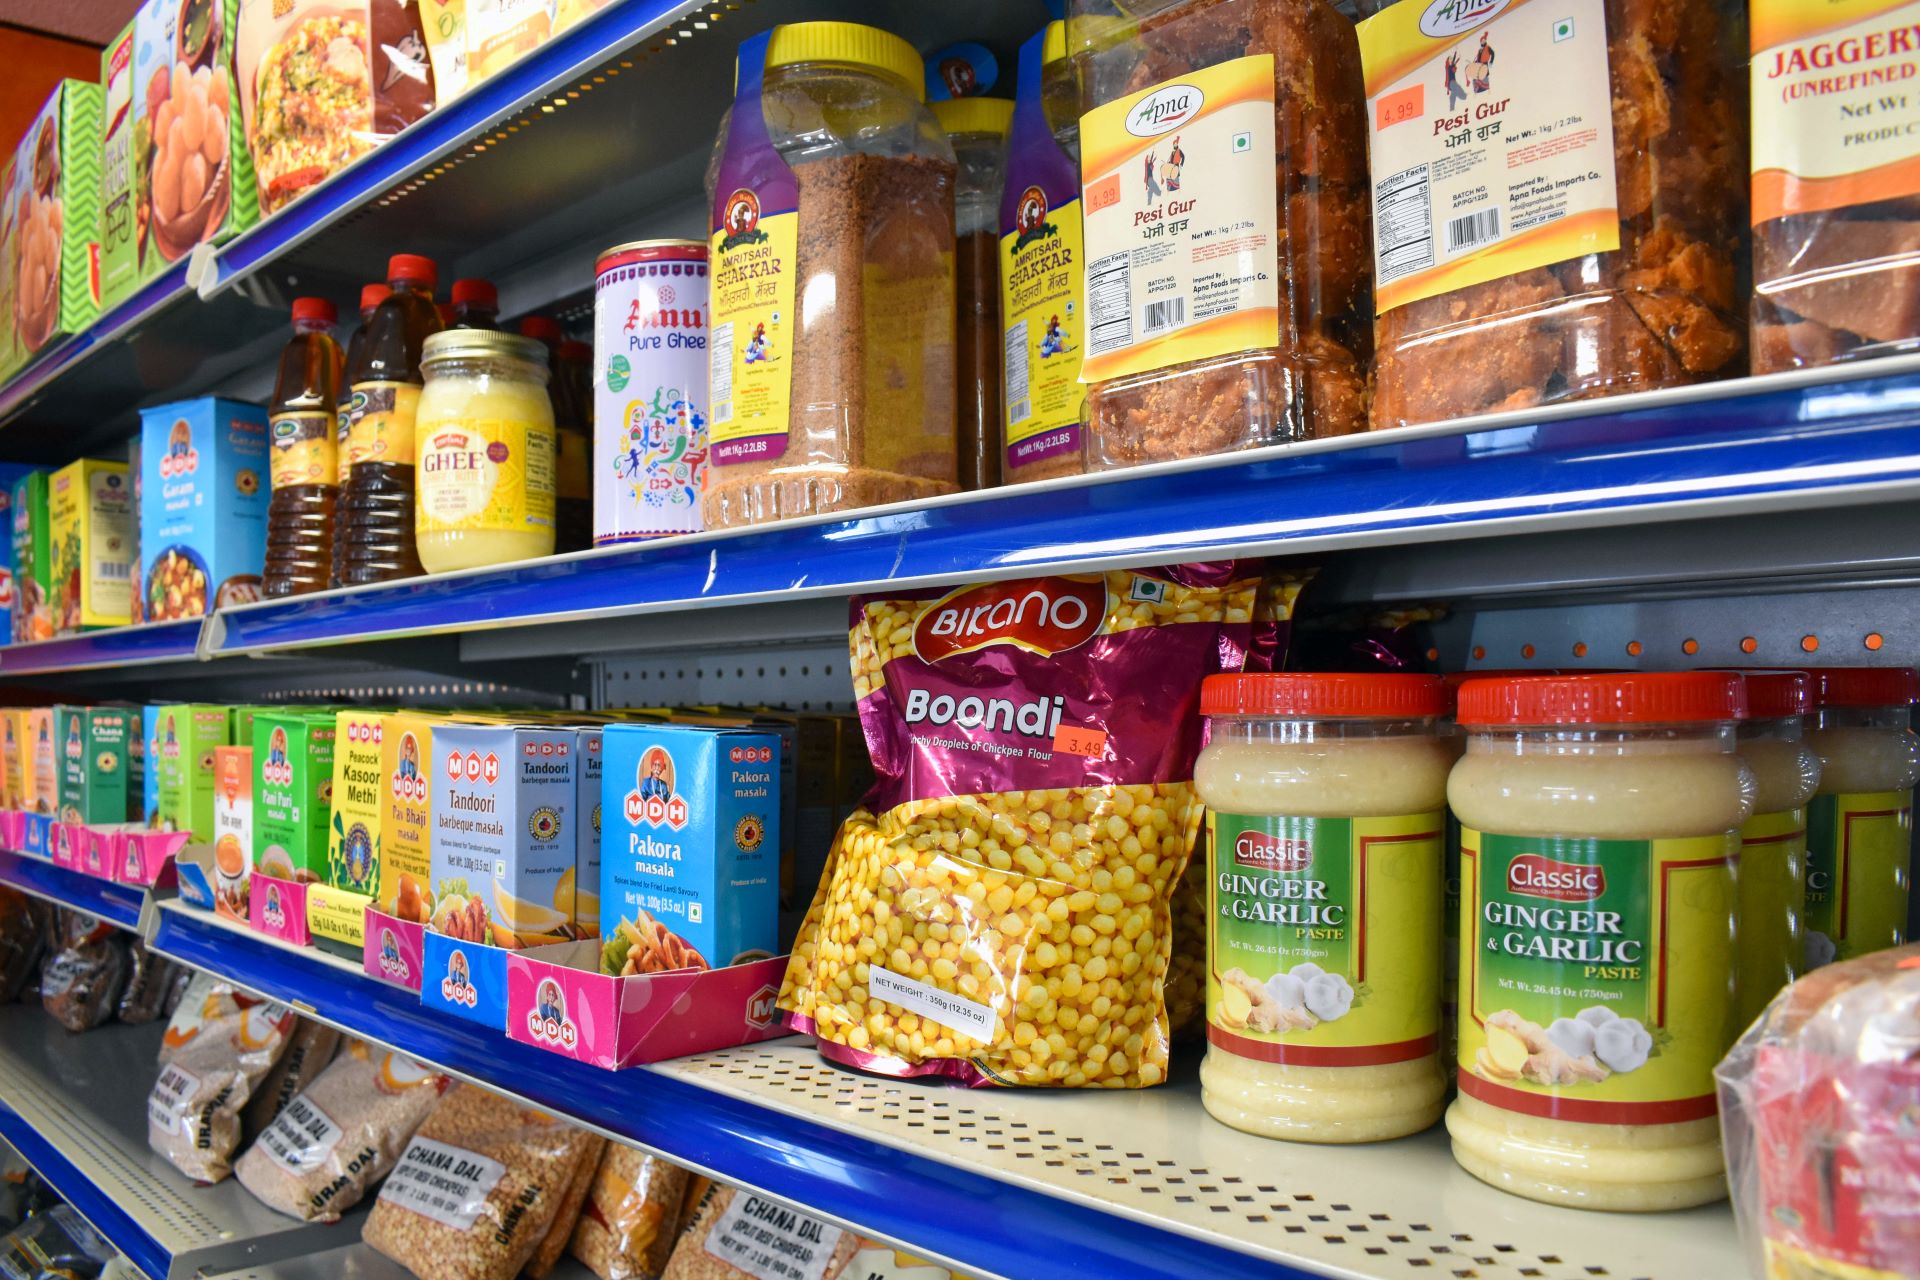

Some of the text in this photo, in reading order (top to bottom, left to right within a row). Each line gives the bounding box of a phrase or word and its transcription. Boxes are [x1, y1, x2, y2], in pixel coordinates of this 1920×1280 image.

[1782, 62, 1917, 104] (UNREFINED
[1135, 95, 1190, 127] Apna
[1384, 101, 1415, 124] 4.99
[1432, 97, 1511, 136] Pesi Gur
[1841, 95, 1908, 120] Net Wt
[1505, 135, 1519, 144] Net
[1539, 124, 1552, 133] 1kg
[1559, 115, 1583, 127] 2.2lbs
[1376, 174, 1404, 191] Nutrition
[1405, 165, 1427, 178] Facts
[1418, 184, 1428, 194] 55
[1509, 171, 1602, 203] Apna Foods Imports Co.
[1092, 188, 1116, 208] 4.99
[1452, 185, 1488, 201] BATCH NO.
[1133, 199, 1197, 227] Pesi Gur
[1191, 231, 1203, 241] Net
[1235, 221, 1255, 232] 2.2lbs
[722, 246, 772, 269] AMRITSARI
[1014, 237, 1062, 270] AMRITSARI
[1111, 252, 1129, 263] Facts
[716, 258, 782, 290] SHAKKAR
[1009, 248, 1073, 292] SHAKKAR
[1121, 269, 1129, 277] 55
[1147, 276, 1176, 288] BATCH NO.
[1192, 282, 1209, 294] Apna
[1210, 279, 1229, 290] Foods
[1257, 272, 1269, 281] Co.
[1194, 308, 1214, 319] PRODUCT
[1214, 306, 1222, 315] OF
[629, 332, 706, 351] Pure Ghee
[424, 452, 485, 473] GHEE
[163, 481, 195, 499] Garam
[905, 688, 1065, 740] Boondi
[348, 726, 382, 739] MDH
[349, 750, 379, 766] Peacock
[524, 743, 569, 754] MDH
[731, 750, 771, 761] MDH
[933, 736, 970, 752] Droplets
[982, 742, 1024, 758] Chickpea
[1027, 747, 1053, 761] Flour
[1069, 738, 1101, 756] 3.49
[449, 757, 499, 778] MDH
[523, 762, 569, 775] Tandoori
[731, 770, 771, 785] Pakora
[393, 780, 425, 797] MDH
[521, 776, 570, 785] barbeque masala
[347, 785, 377, 806] Methi
[449, 790, 495, 814] Tandoori
[735, 787, 767, 798] masala
[392, 804, 427, 830] Pav Bhaji
[628, 799, 684, 822] MDH
[439, 813, 504, 837] barbeque masala
[629, 833, 682, 862] Pakora
[1235, 838, 1306, 863] Classic
[525, 867, 546, 875] Produce
[552, 866, 565, 874] India
[635, 861, 675, 878] masala
[1509, 863, 1599, 890] Classic
[614, 875, 630, 887] Spices
[630, 878, 643, 889] blend
[642, 880, 650, 890] for
[650, 882, 663, 892] Fried
[677, 886, 700, 899] Savoury
[1219, 872, 1328, 901] GINGER
[1540, 888, 1565, 897] Quality
[625, 891, 685, 917] Net Wt. 100g (3.5 oz.)
[1221, 899, 1344, 926] & GARLIC
[1484, 901, 1623, 935] GINGER
[1295, 928, 1345, 940] PASTE
[1487, 932, 1642, 964] & GARLIC
[379, 957, 408, 978] MDH
[1584, 966, 1642, 980] PASTE
[443, 982, 476, 1003] MDH
[875, 977, 891, 988] NET
[892, 982, 924, 999] WEIGHT
[929, 995, 948, 1010] 350g
[949, 1002, 972, 1018] (12.35
[973, 1012, 985, 1025] oz)
[1517, 981, 1532, 992] Wt.
[1533, 984, 1561, 995] 26.45
[1563, 987, 1577, 997] Oz
[1579, 988, 1623, 1001] (750gm)
[529, 1018, 574, 1044] MDH
[406, 1146, 485, 1183] CHANA DAL
[743, 1197, 797, 1233] CHANA
[797, 1218, 823, 1245] DAL
